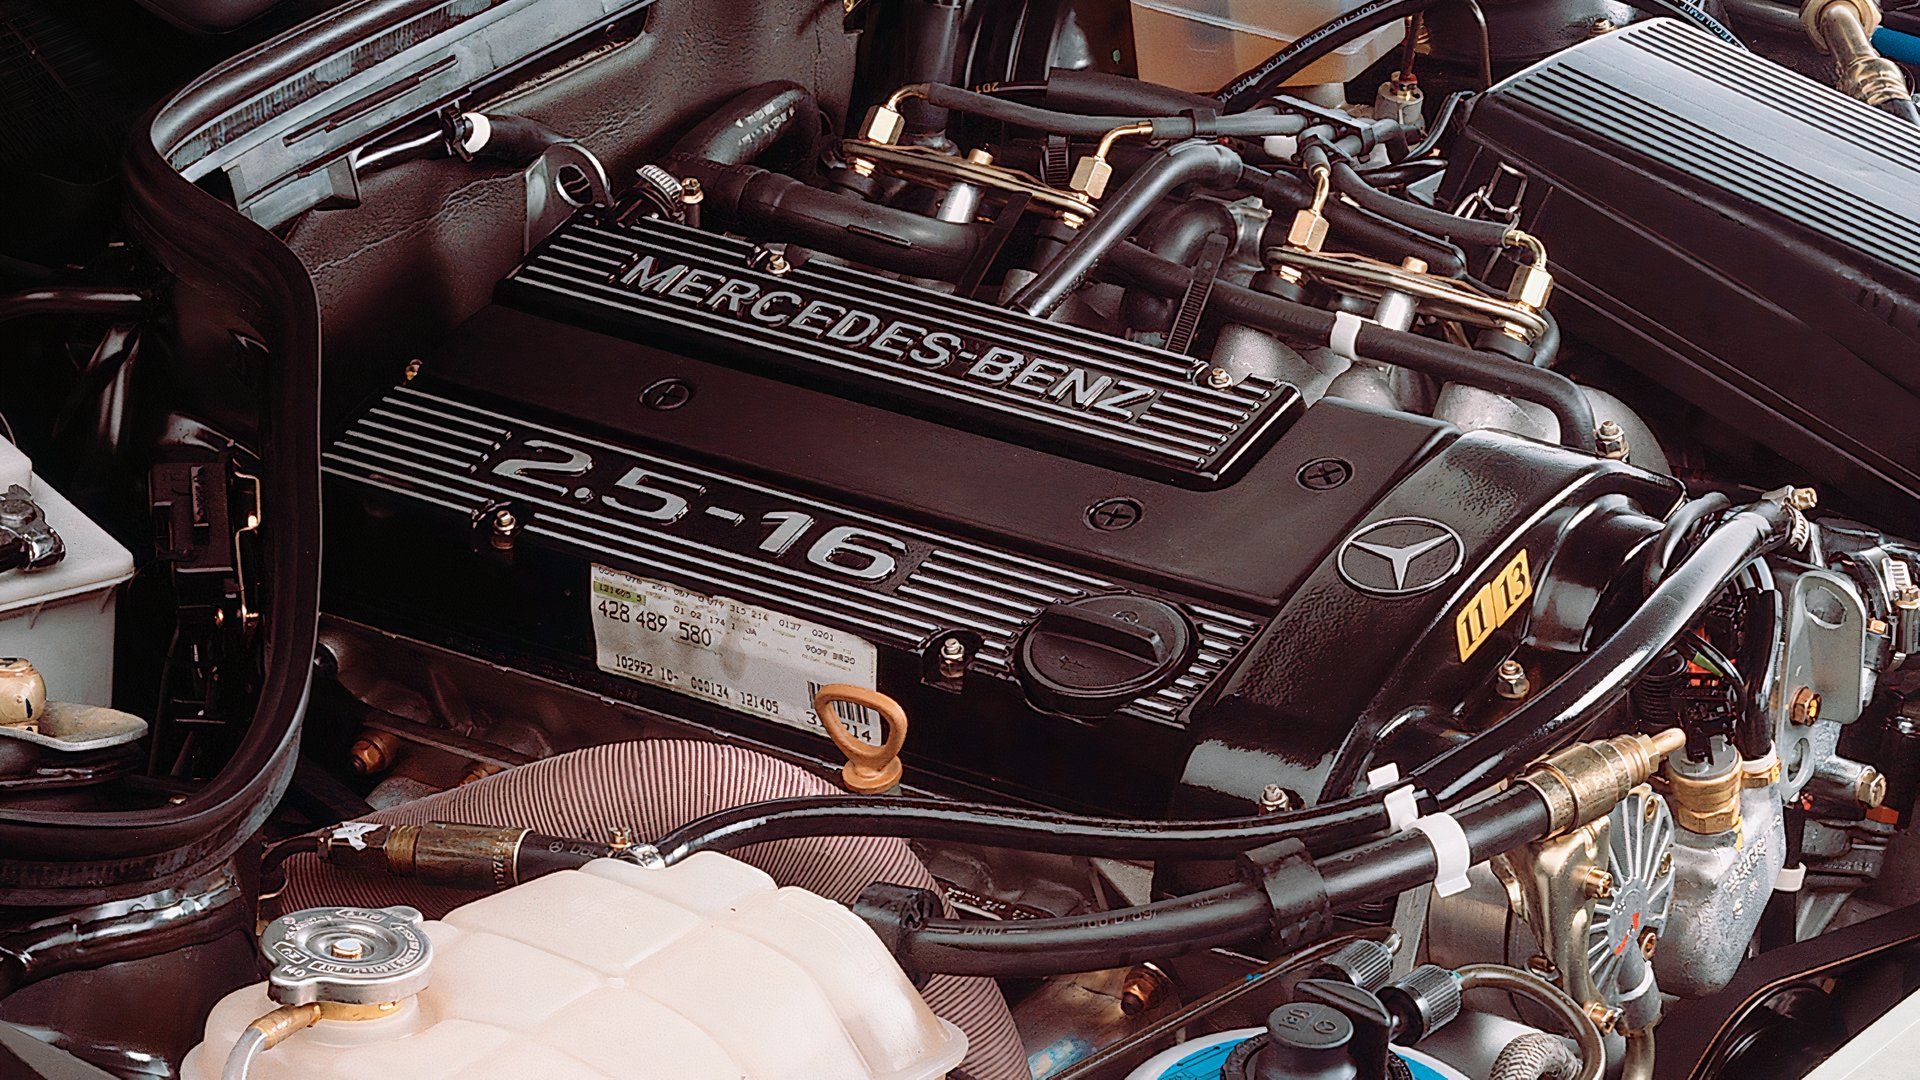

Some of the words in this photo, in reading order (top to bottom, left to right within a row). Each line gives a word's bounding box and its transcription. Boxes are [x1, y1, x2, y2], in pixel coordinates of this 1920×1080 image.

[620, 254, 1157, 420] MERCEDES-BENZ
[491, 438, 910, 583] 2.5-16
[598, 599, 631, 623] 428
[635, 610, 668, 633] 489
[679, 621, 712, 647] 580
[673, 605, 685, 615] 01
[778, 619, 802, 632] 0137
[811, 628, 835, 642] 0201
[1461, 598, 1489, 651] 11
[1499, 561, 1527, 614] 13
[615, 654, 654, 677] 102992
[740, 691, 780, 714] 121405
